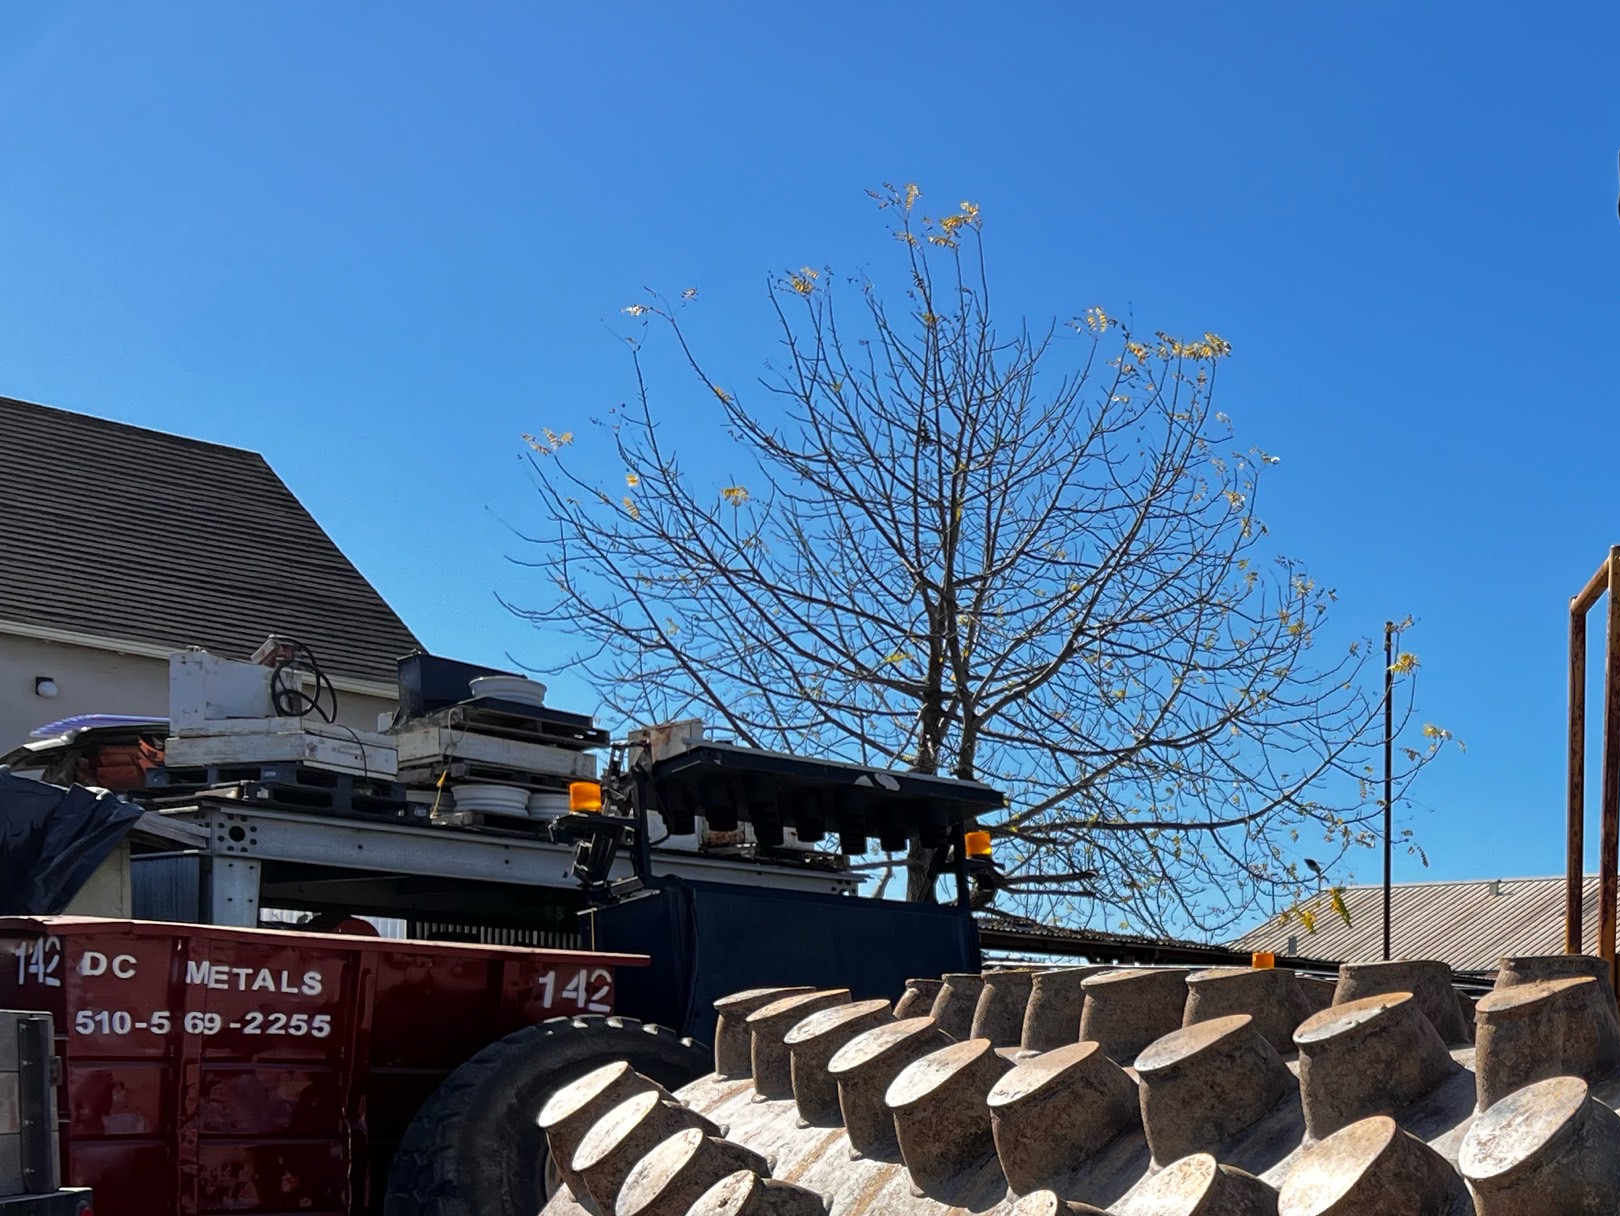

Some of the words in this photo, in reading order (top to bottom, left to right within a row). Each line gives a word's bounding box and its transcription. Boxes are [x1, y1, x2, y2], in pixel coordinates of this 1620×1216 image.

[14, 936, 61, 987] 142
[82, 951, 138, 979] DC
[185, 960, 323, 995] METALS
[538, 968, 612, 1013] 142
